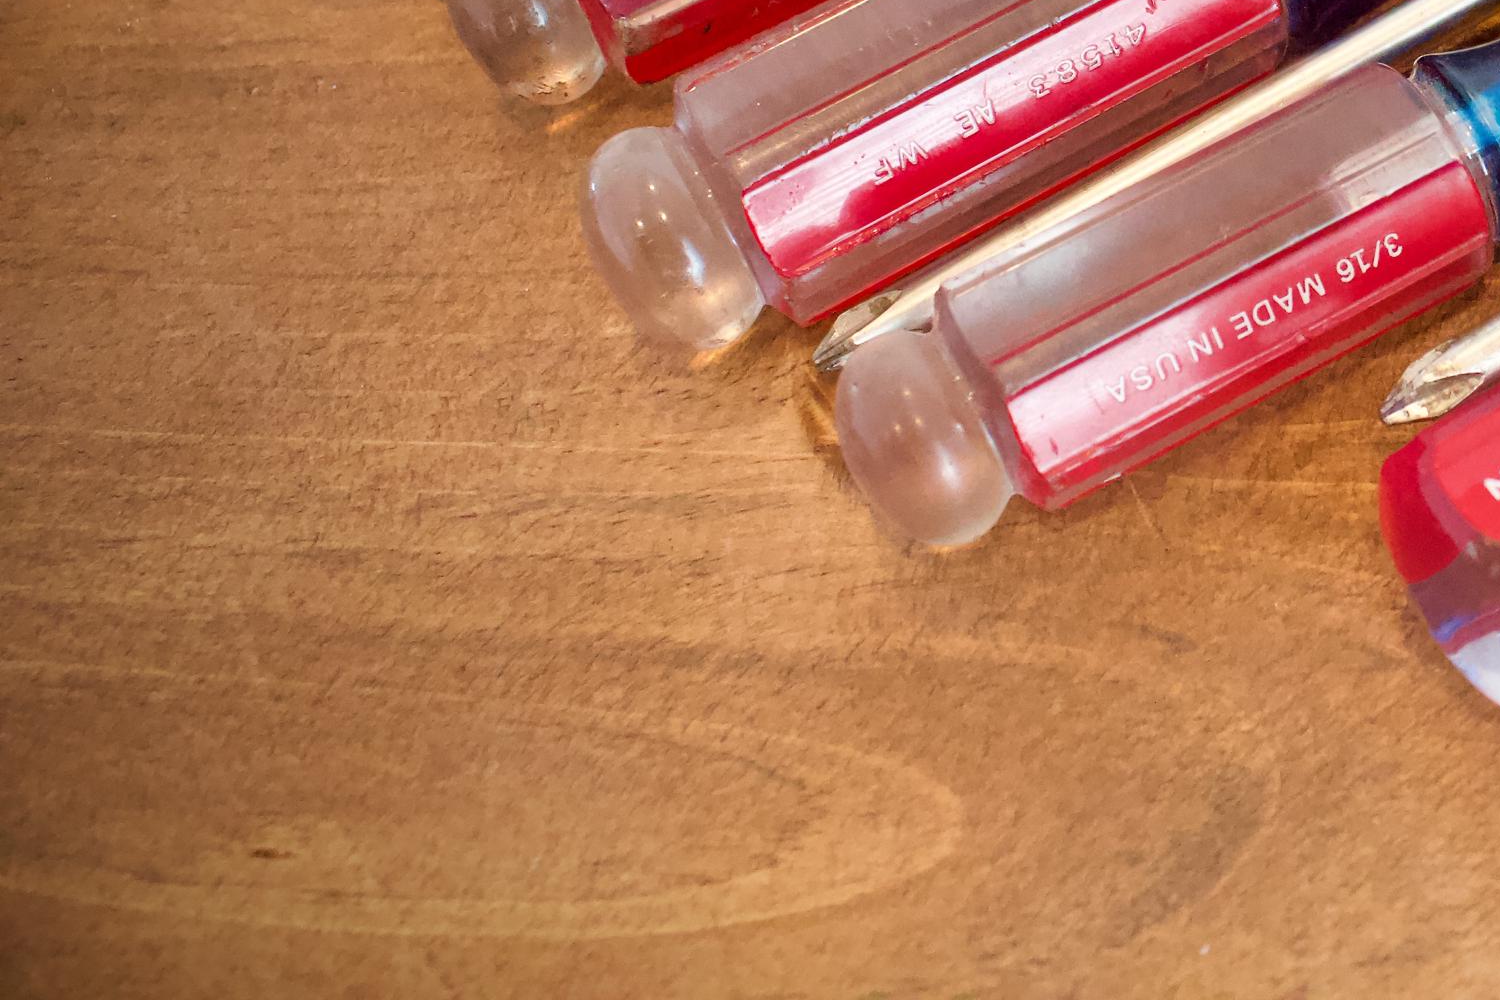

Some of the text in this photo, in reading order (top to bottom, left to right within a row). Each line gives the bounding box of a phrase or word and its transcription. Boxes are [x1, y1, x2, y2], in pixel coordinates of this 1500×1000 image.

[874, 21, 1147, 186] 41583 AE WF
[1105, 232, 1404, 404] 3/16 MADE IN USA
